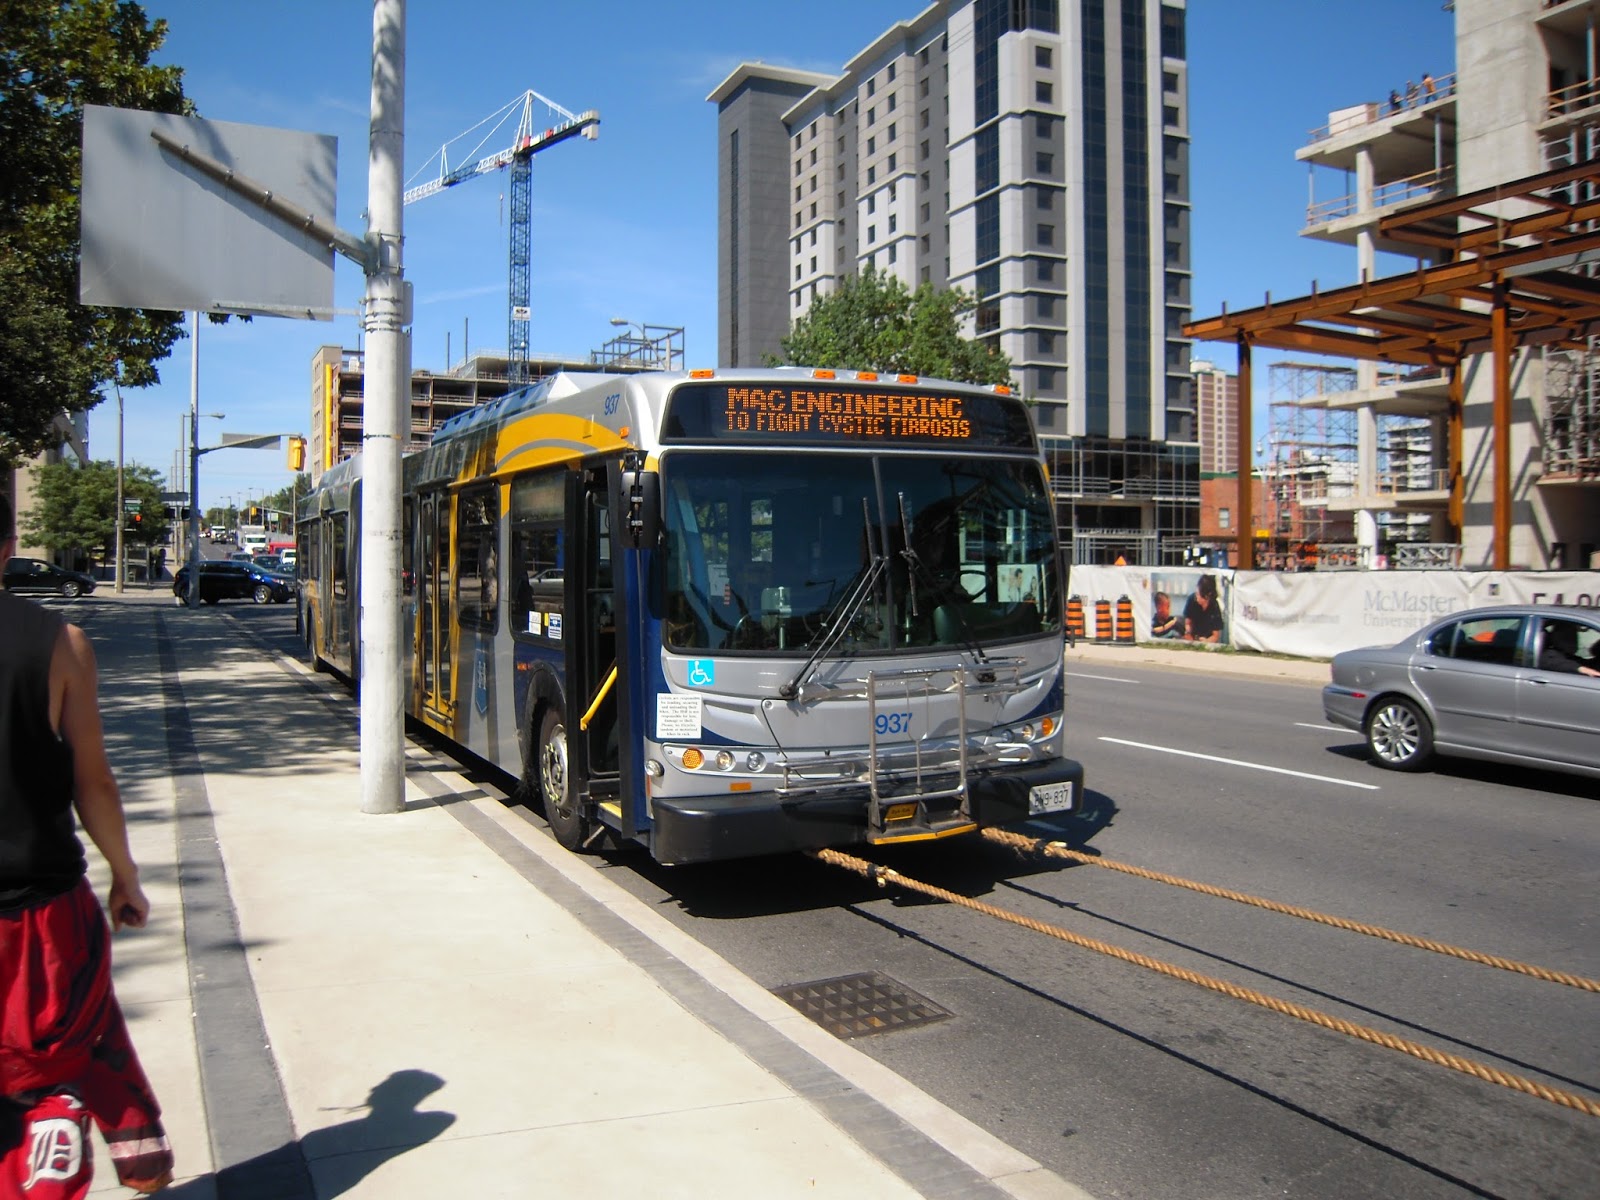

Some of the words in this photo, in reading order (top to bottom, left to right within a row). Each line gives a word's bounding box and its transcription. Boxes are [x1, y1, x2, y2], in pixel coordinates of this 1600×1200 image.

[604, 394, 620, 416] 937
[728, 388, 786, 411] MAC
[725, 411, 750, 430] TO
[756, 412, 812, 432] FIGHT
[819, 414, 885, 435] CYSTIC
[1363, 589, 1457, 614] McMaster
[1363, 613, 1428, 629] University
[875, 712, 913, 735] 937
[22, 1117, 83, 1190] D
